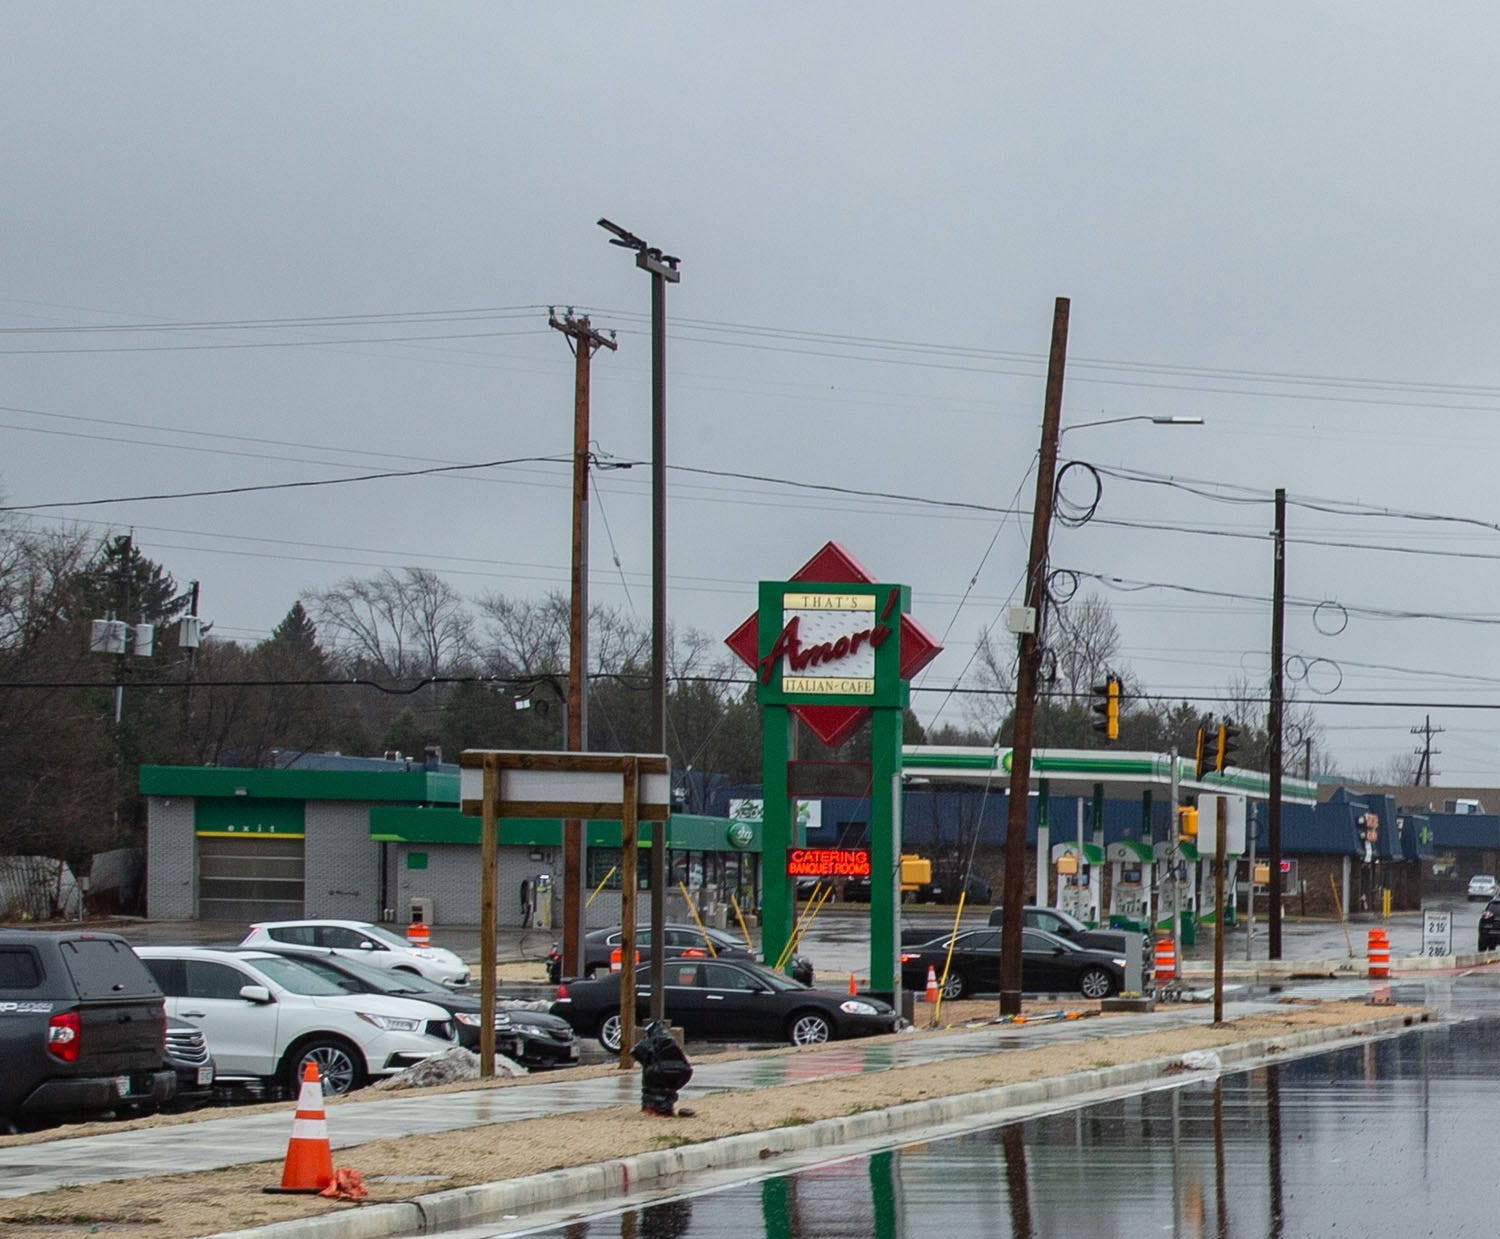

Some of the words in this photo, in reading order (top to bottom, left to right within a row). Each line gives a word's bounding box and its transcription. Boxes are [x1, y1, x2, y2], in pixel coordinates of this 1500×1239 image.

[802, 596, 858, 609] THAT'S
[227, 823, 275, 833] exit
[791, 850, 868, 863] CATERING
[789, 862, 834, 875] BANQUET
[834, 862, 870, 875] ROOMS
